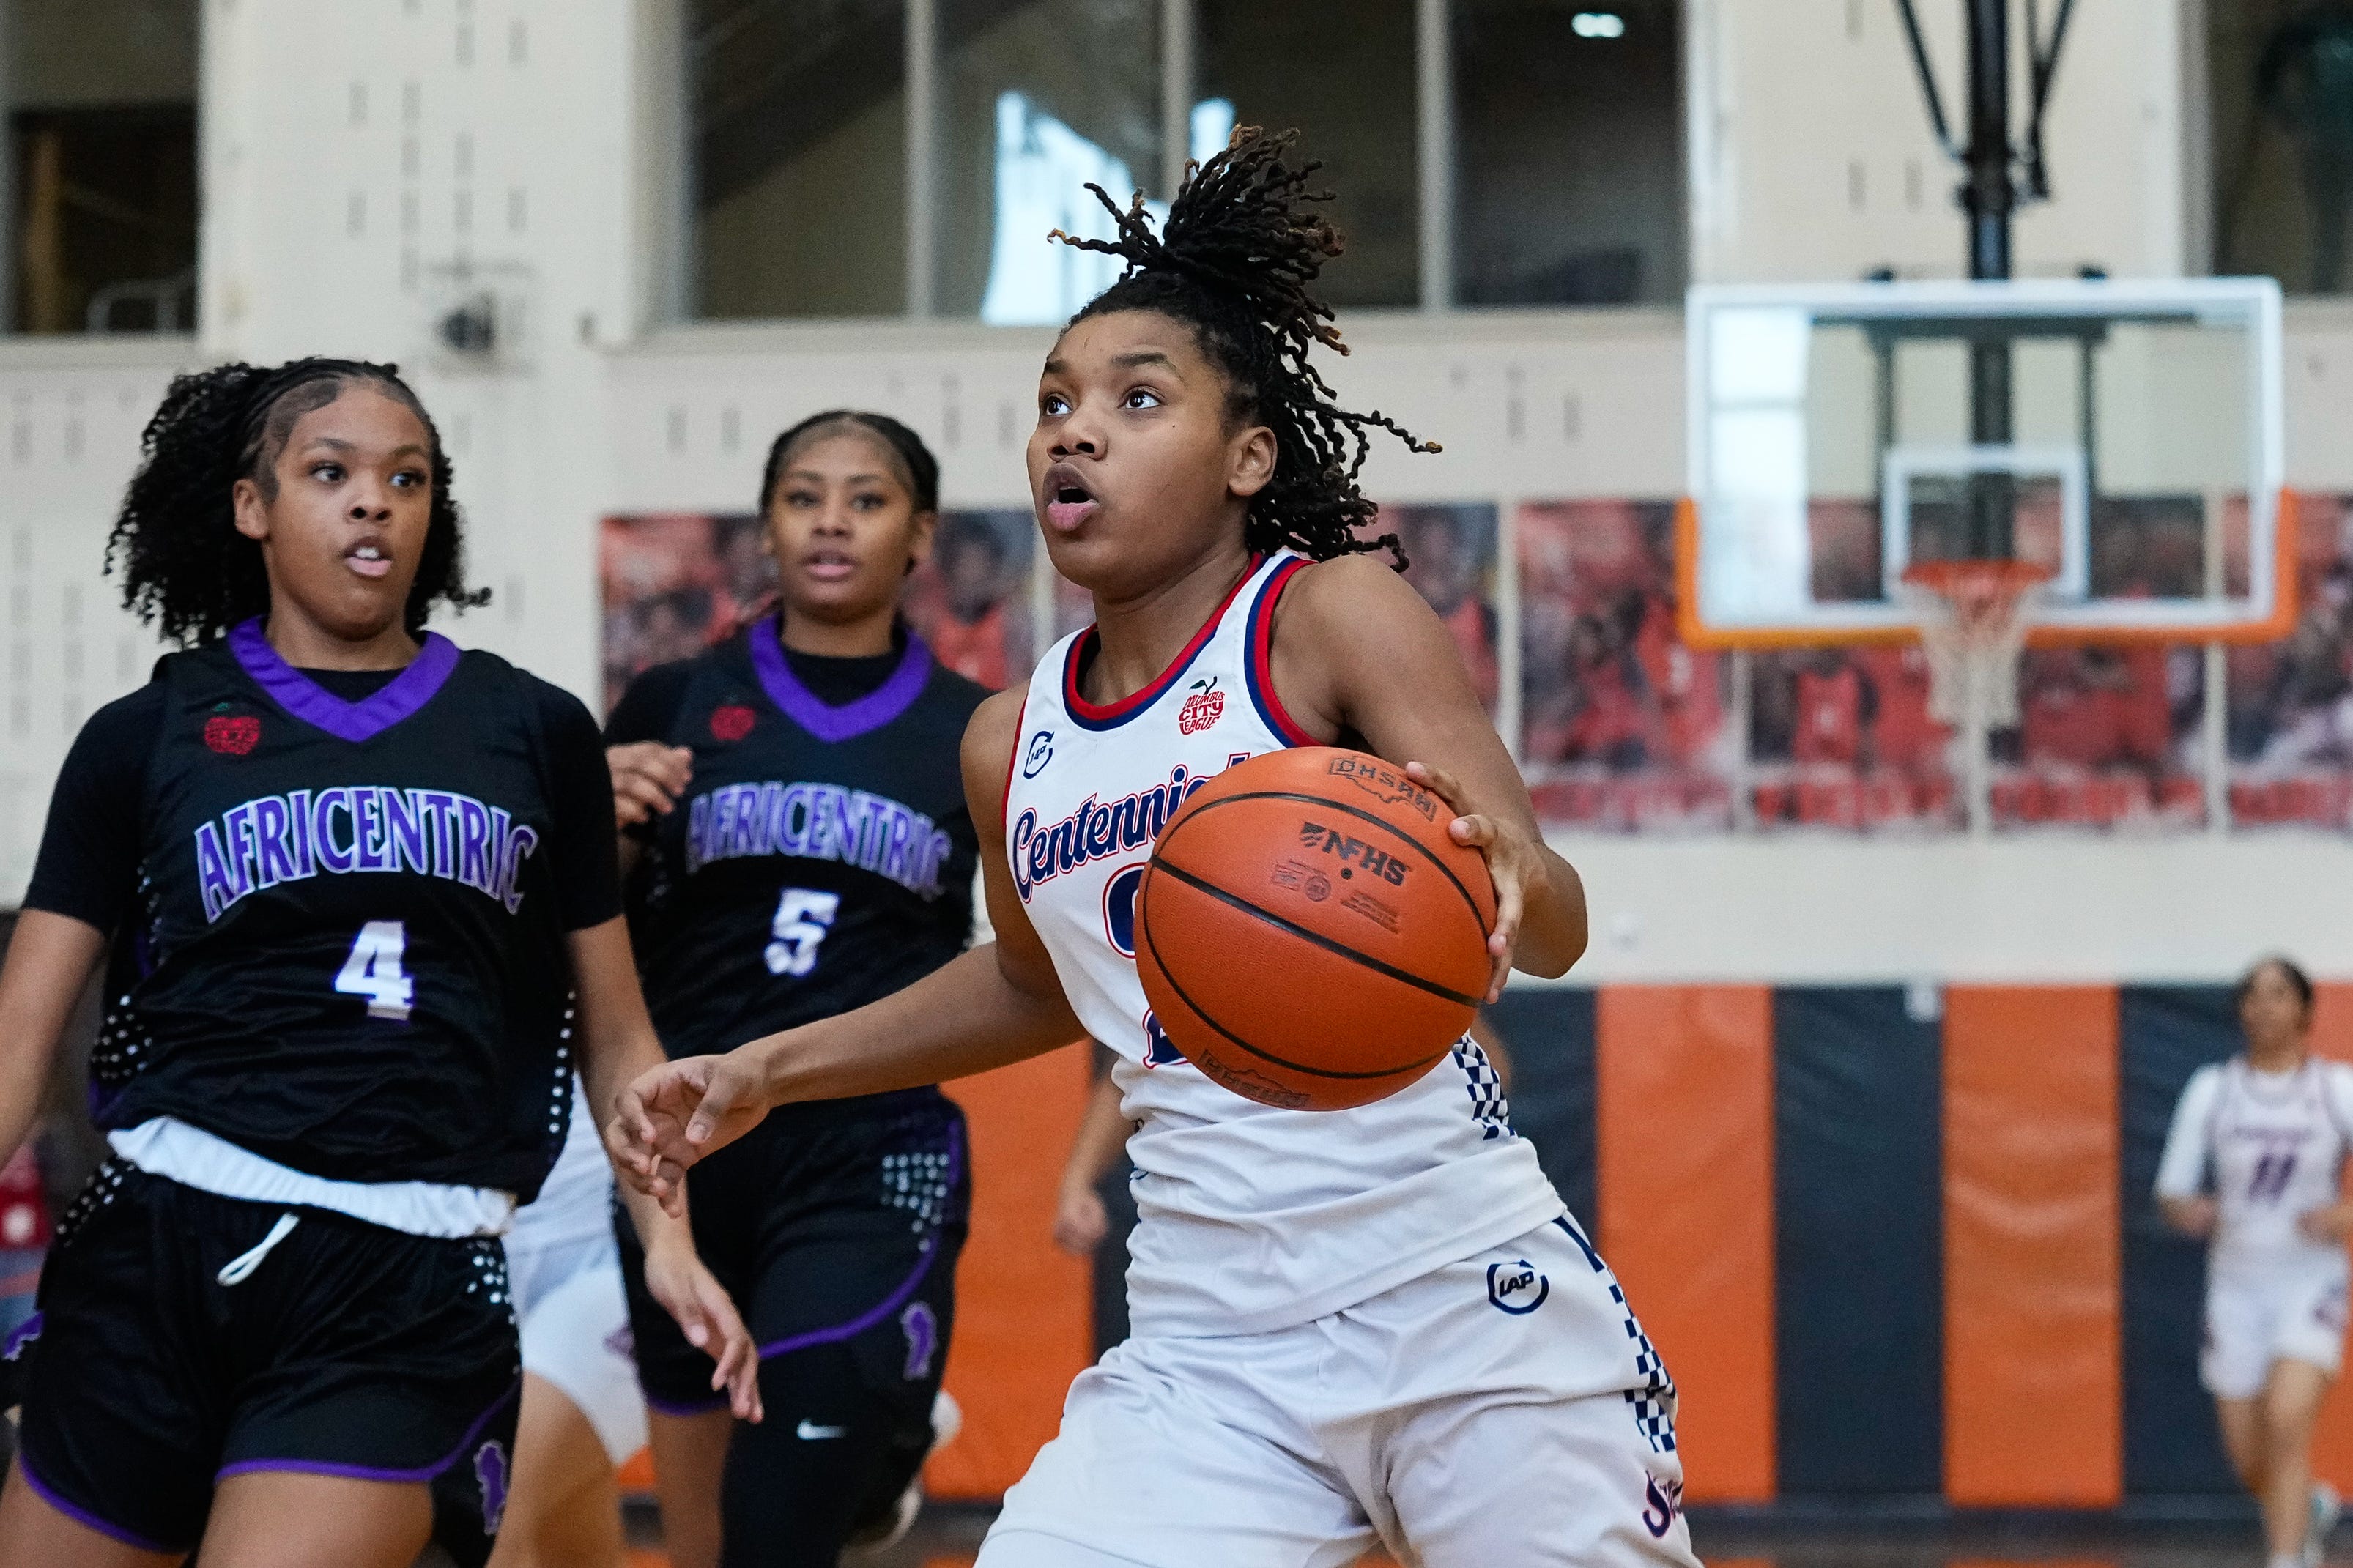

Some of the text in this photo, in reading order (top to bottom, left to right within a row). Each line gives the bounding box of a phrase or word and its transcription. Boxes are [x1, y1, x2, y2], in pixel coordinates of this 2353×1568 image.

[1179, 701, 1224, 721] CITY
[194, 785, 538, 924] AFRICENTRIC
[685, 781, 952, 903] AFRICENTRIC
[1012, 752, 1250, 904] Centenni
[1322, 828, 1409, 887] NFHS
[334, 920, 413, 1020] 4
[764, 887, 840, 976] 5
[1499, 1270, 1535, 1299] LAP
